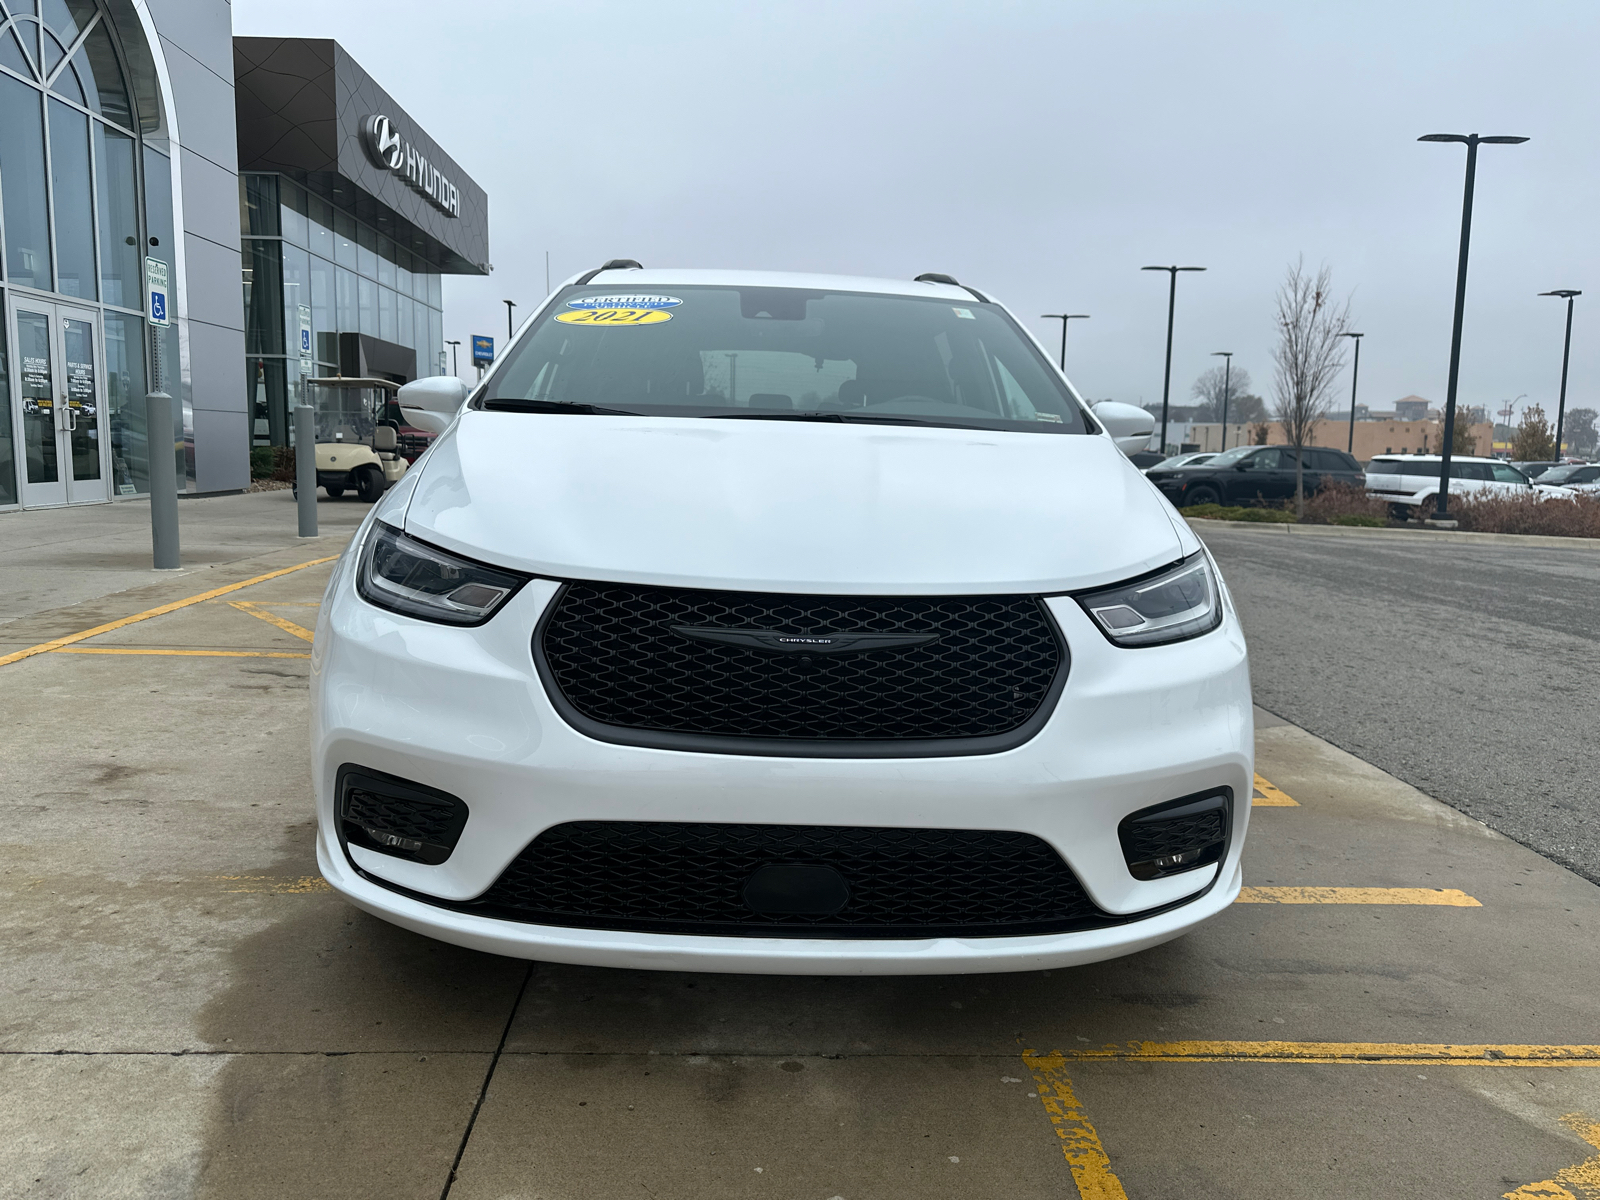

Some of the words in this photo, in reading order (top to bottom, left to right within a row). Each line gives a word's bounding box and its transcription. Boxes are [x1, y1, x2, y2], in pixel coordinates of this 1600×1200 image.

[406, 142, 460, 218] HYUNDAI
[147, 264, 167, 277] RESERVED
[148, 275, 167, 288] PARKING
[571, 310, 654, 322] 2021
